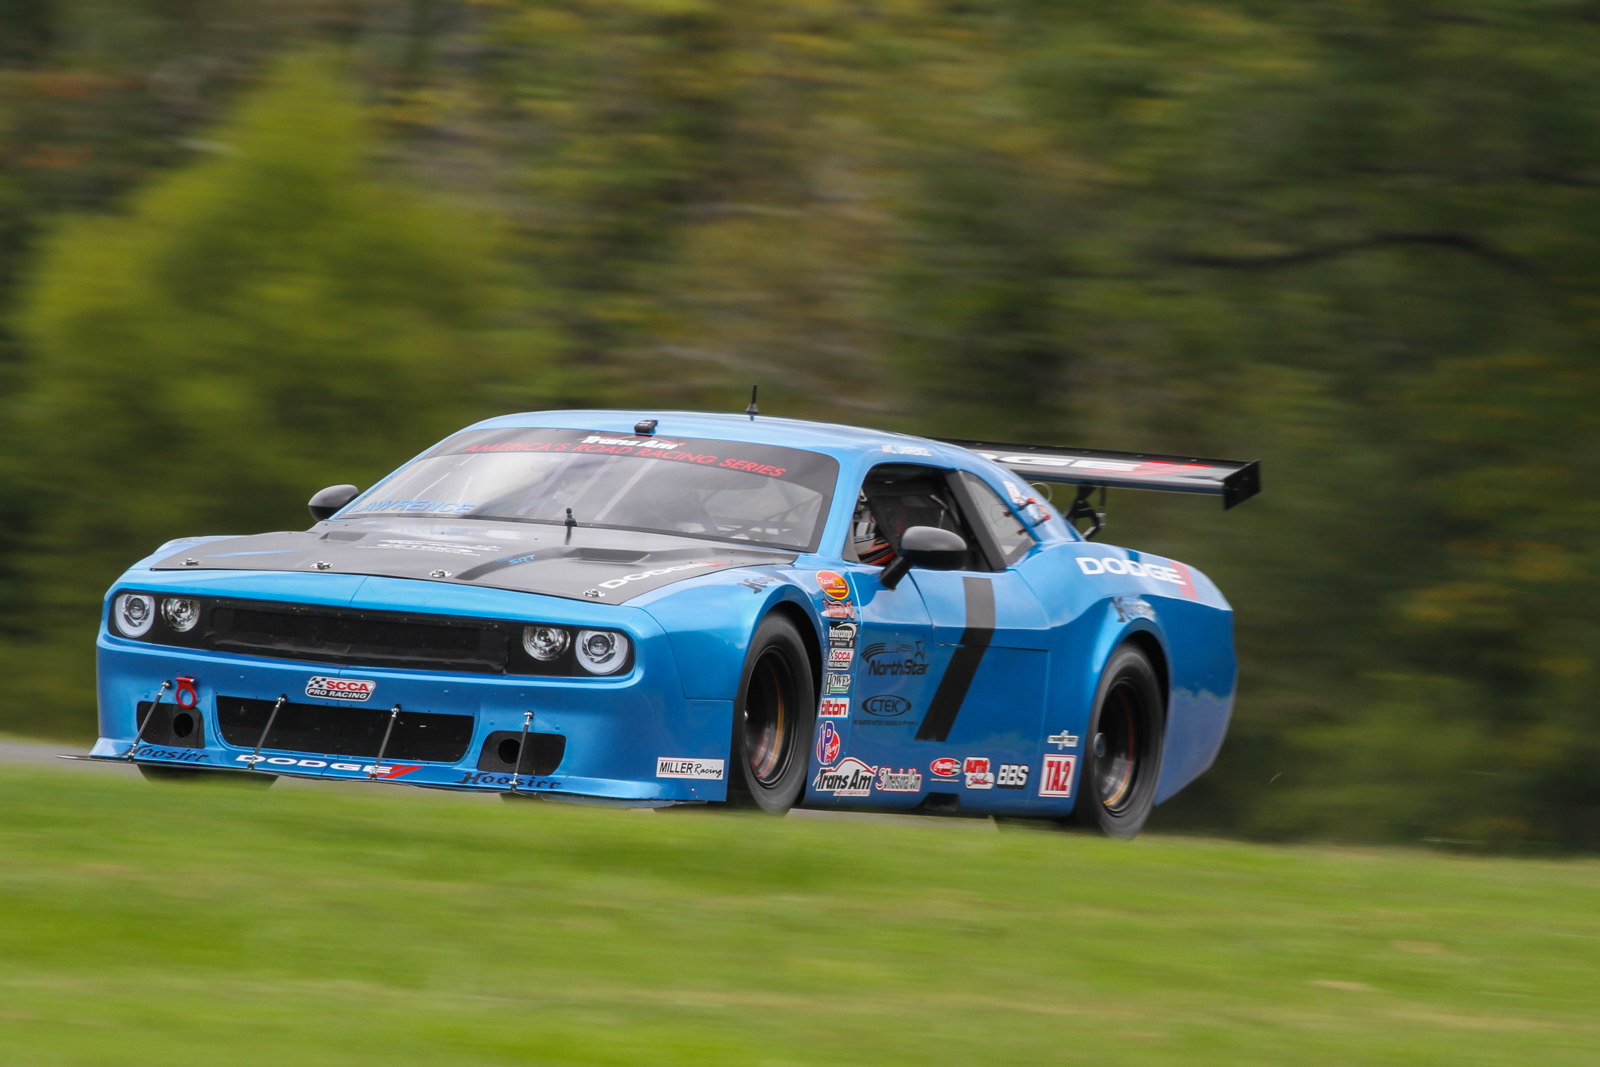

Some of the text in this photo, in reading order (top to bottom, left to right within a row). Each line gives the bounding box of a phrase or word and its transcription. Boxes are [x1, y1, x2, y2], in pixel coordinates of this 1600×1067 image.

[580, 435, 679, 450] Trans Am
[461, 442, 787, 477] AMERICA'S ROAD RACING SERIES
[348, 500, 476, 514] LAWRENCE
[1075, 557, 1188, 586] DODGE
[834, 651, 851, 661] SCCA
[867, 658, 930, 676] NorthStar
[308, 688, 367, 699] PRO RACING
[326, 680, 370, 692] SCCA
[870, 699, 899, 713] CTEK
[235, 754, 393, 774] DODGE
[659, 761, 723, 778] MILLER Racing
[453, 771, 562, 789] Hoosier
[817, 769, 872, 790] Trans Am
[996, 764, 1030, 788] BBS
[1045, 760, 1071, 791] TA2
